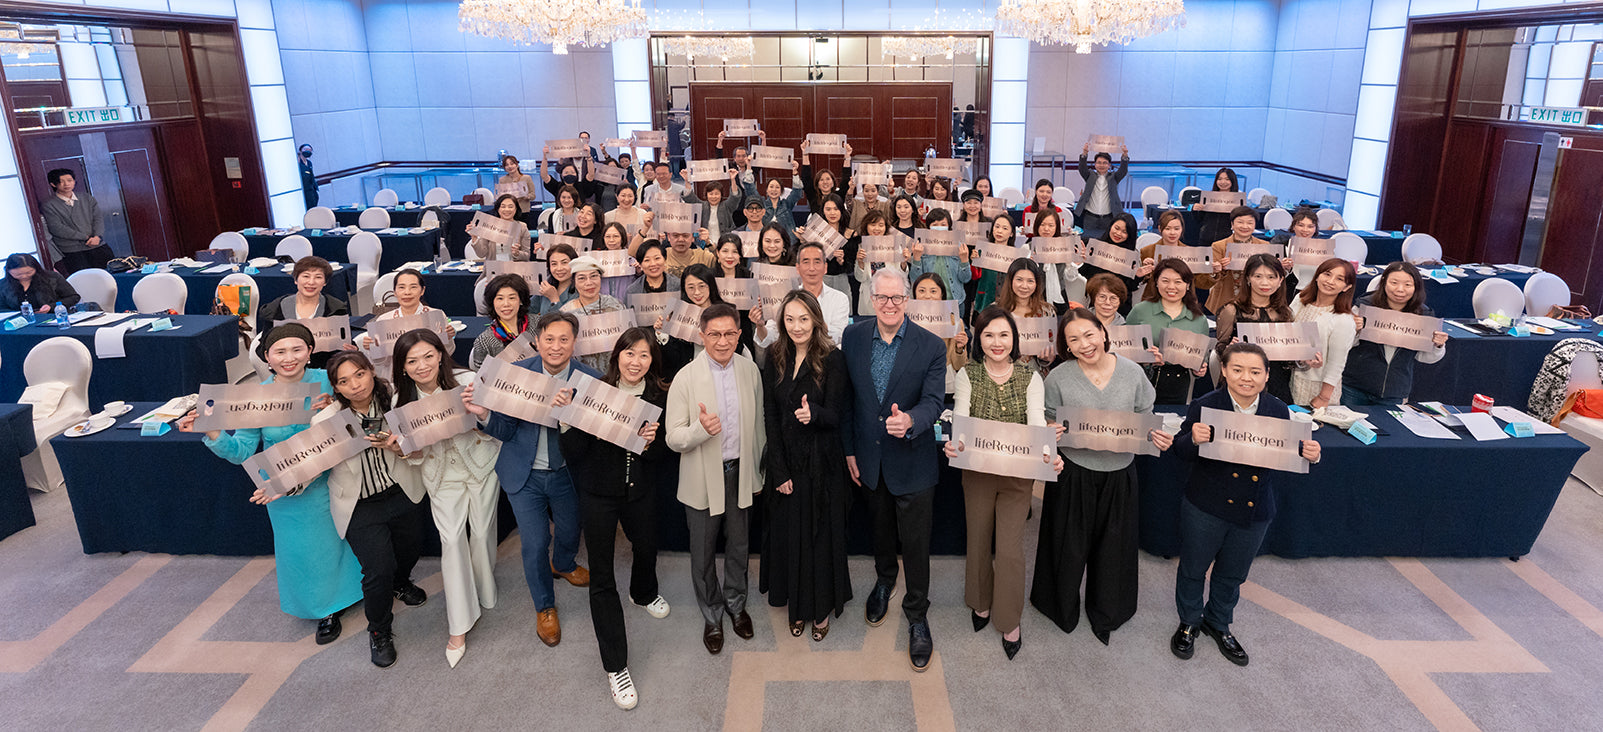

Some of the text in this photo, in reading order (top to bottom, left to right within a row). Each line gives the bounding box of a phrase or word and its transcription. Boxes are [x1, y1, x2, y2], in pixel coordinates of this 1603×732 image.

[68, 109, 119, 123] EXIT 出口
[1531, 108, 1582, 123] EXIT 出口
[1373, 319, 1421, 336] lifeRegen
[494, 378, 546, 403] lifeRegen
[229, 401, 294, 413] lifeRegen
[582, 395, 632, 424] lifeRegen
[410, 408, 455, 430] lifeRegen
[1078, 422, 1134, 436] lifeRegen
[1224, 428, 1284, 448] lifeRegen
[276, 436, 337, 472] lifeRegen
[974, 437, 1031, 455] lifeRegen
